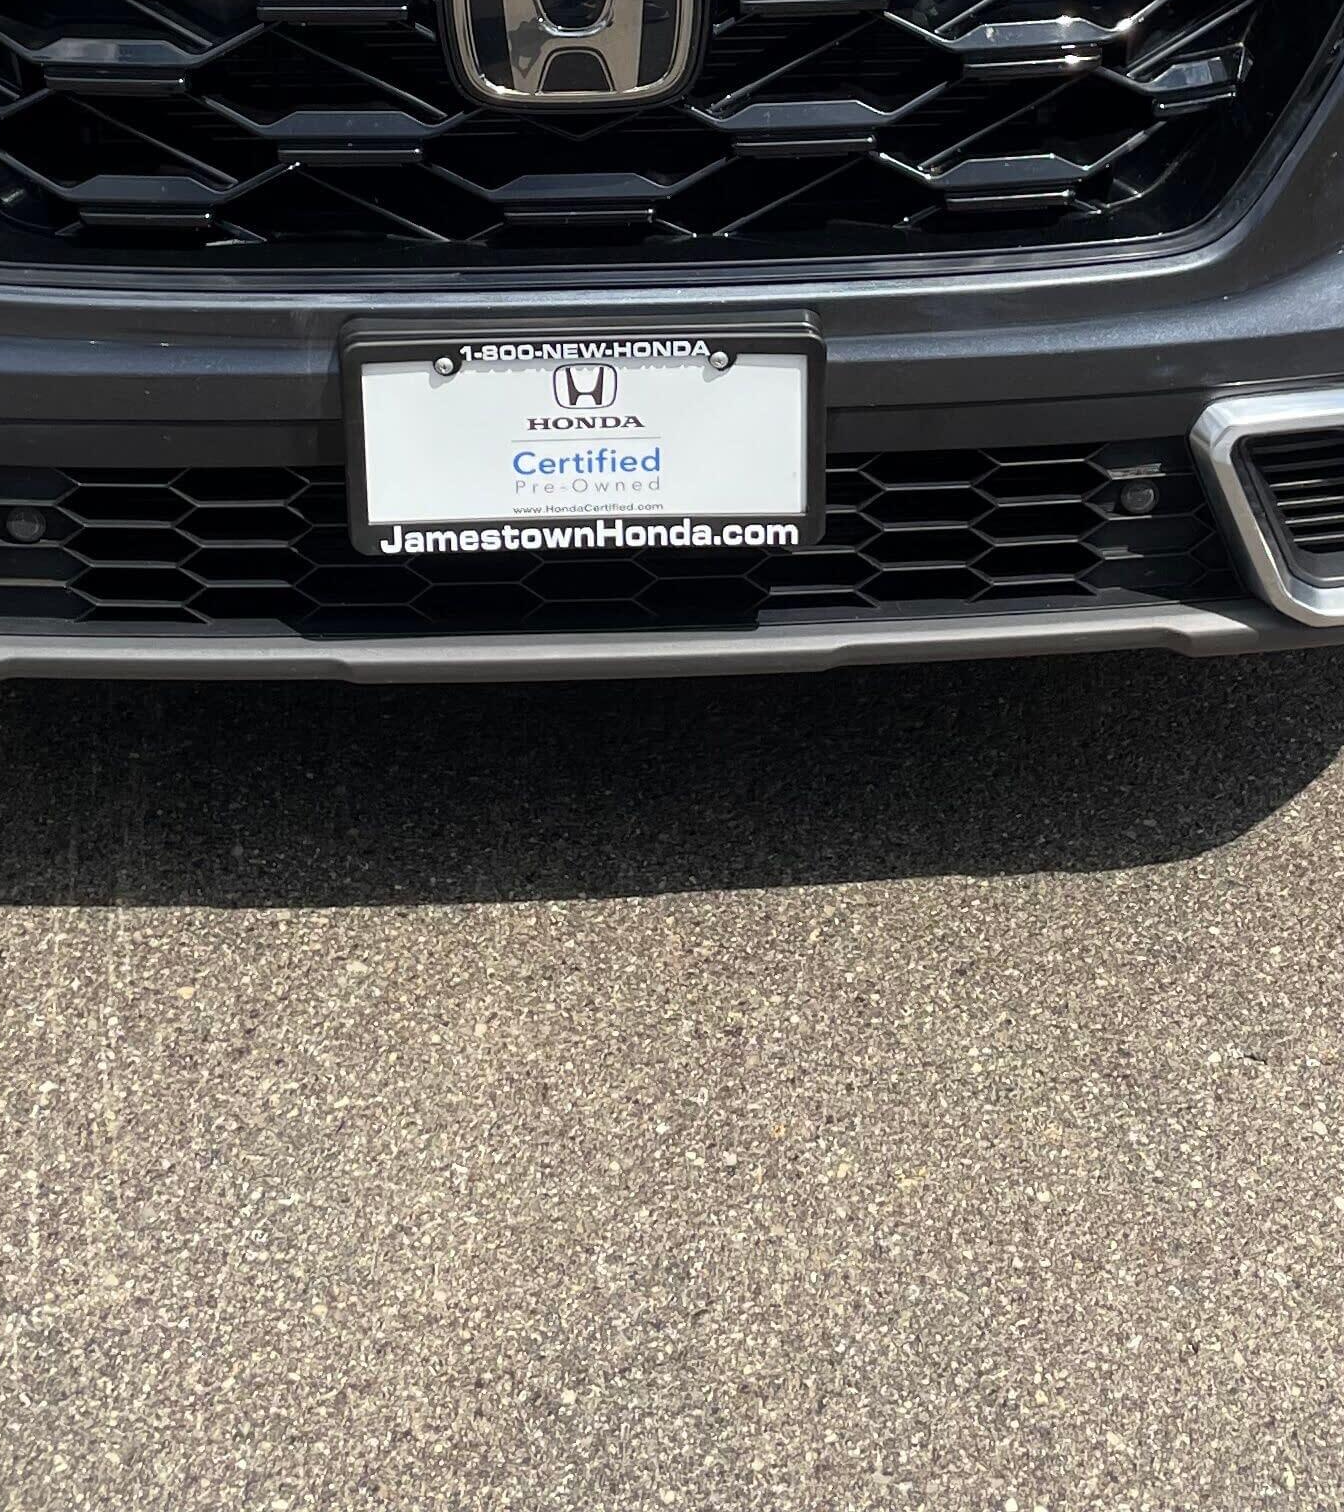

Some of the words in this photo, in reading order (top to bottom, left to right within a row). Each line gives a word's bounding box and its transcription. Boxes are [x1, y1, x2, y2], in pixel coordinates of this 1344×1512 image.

[459, 340, 711, 362] 1-800-NEW-HONDA
[527, 415, 645, 431] HONDA
[512, 446, 660, 476] Certified
[514, 475, 661, 495] Pre-Owned
[512, 501, 664, 515] www.HondaCertified.com
[379, 518, 800, 554] JamestownHonda.com
